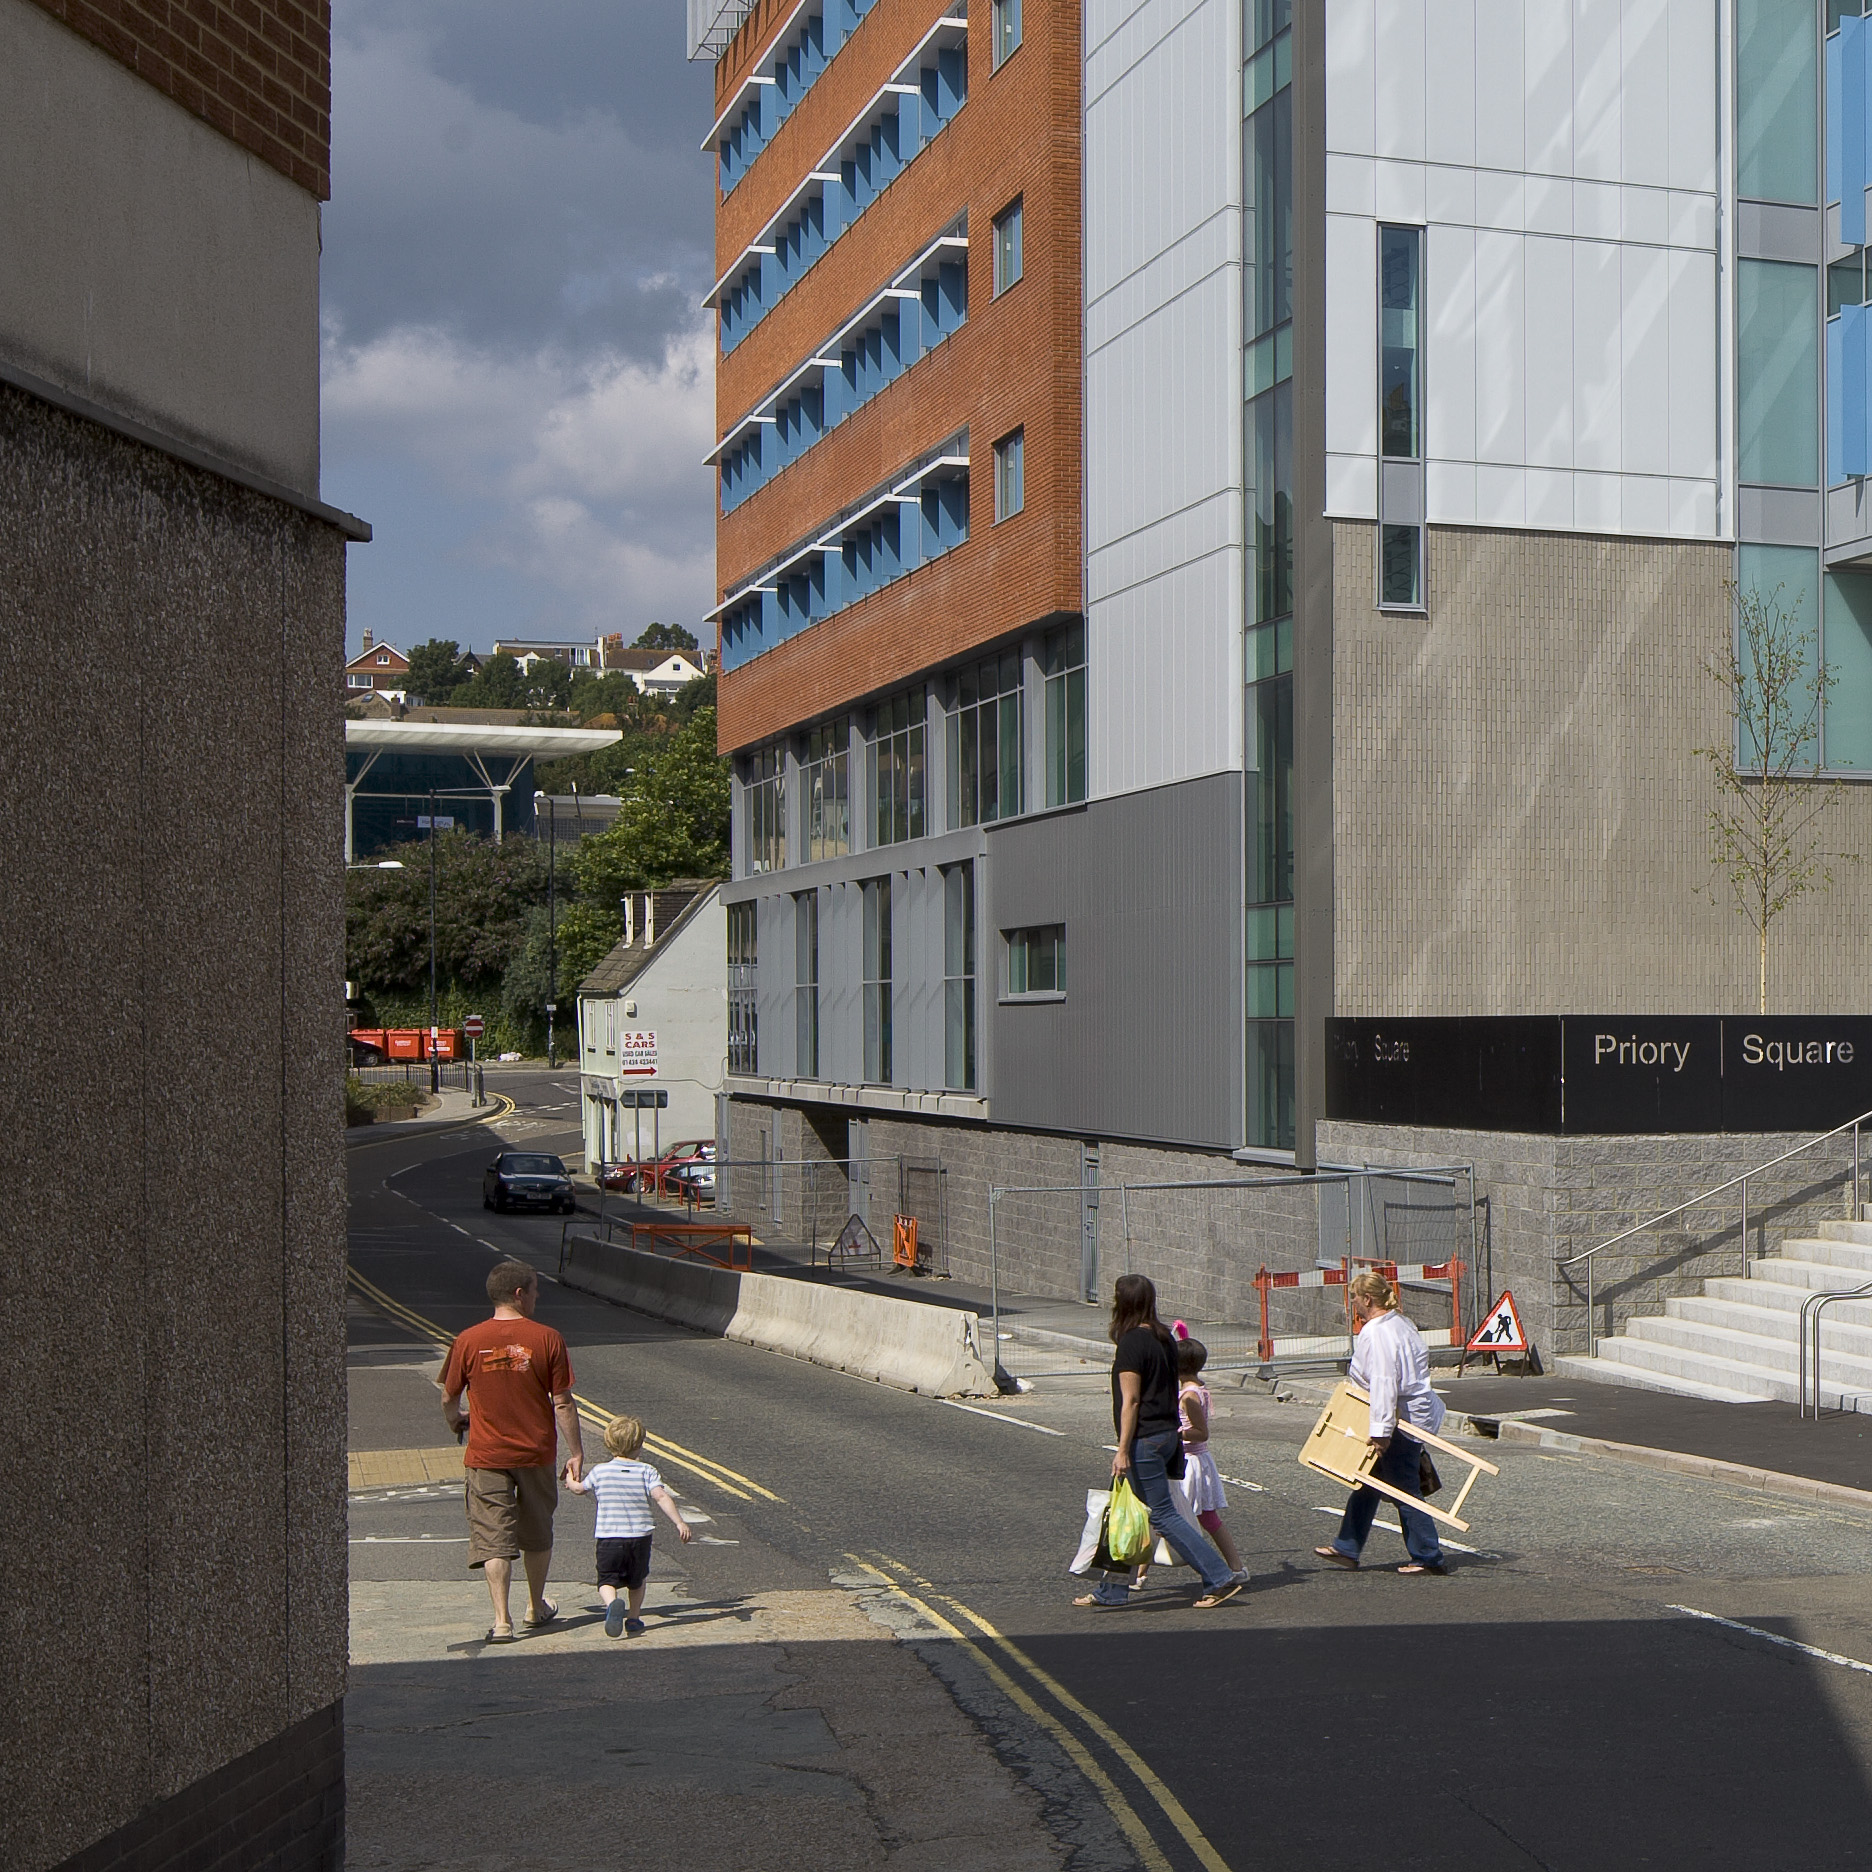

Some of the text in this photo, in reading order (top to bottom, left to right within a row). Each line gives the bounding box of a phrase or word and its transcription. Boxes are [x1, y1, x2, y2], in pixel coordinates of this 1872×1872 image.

[648, 1032, 655, 1040] S
[1594, 1034, 1854, 1072] Priory Square
